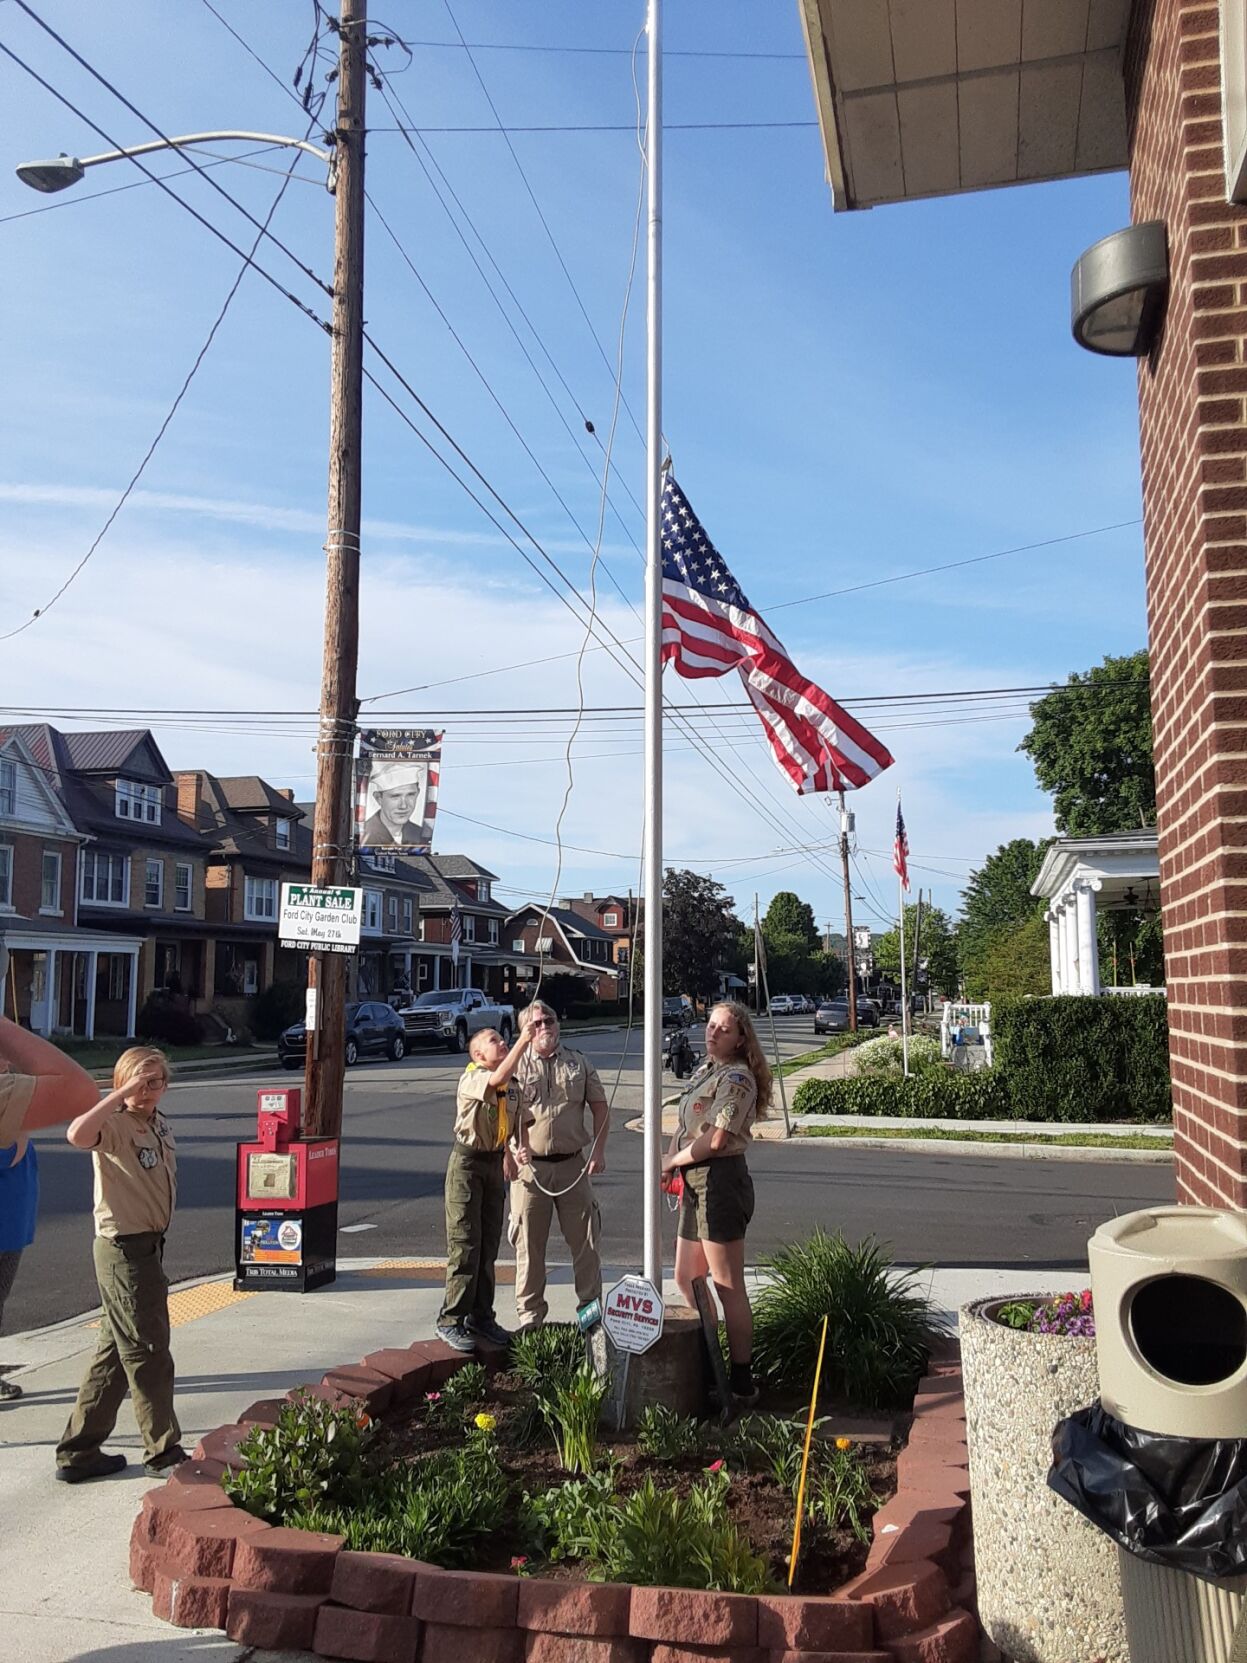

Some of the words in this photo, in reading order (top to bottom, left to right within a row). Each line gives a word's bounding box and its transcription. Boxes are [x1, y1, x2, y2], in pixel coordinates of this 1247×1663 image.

[290, 893, 323, 907] PLANT
[325, 896, 352, 909] SALE
[283, 909, 299, 920] Ford
[300, 910, 314, 923] City
[315, 912, 340, 923] Garden
[341, 913, 358, 925] Club
[311, 927, 326, 938] May
[280, 940, 296, 948] FORD
[297, 941, 311, 950] CITY
[310, 942, 331, 951] PUBLIC
[331, 944, 357, 954] LIBRARY
[259, 1267, 278, 1277] TOTAL
[617, 1293, 653, 1314] MVS
